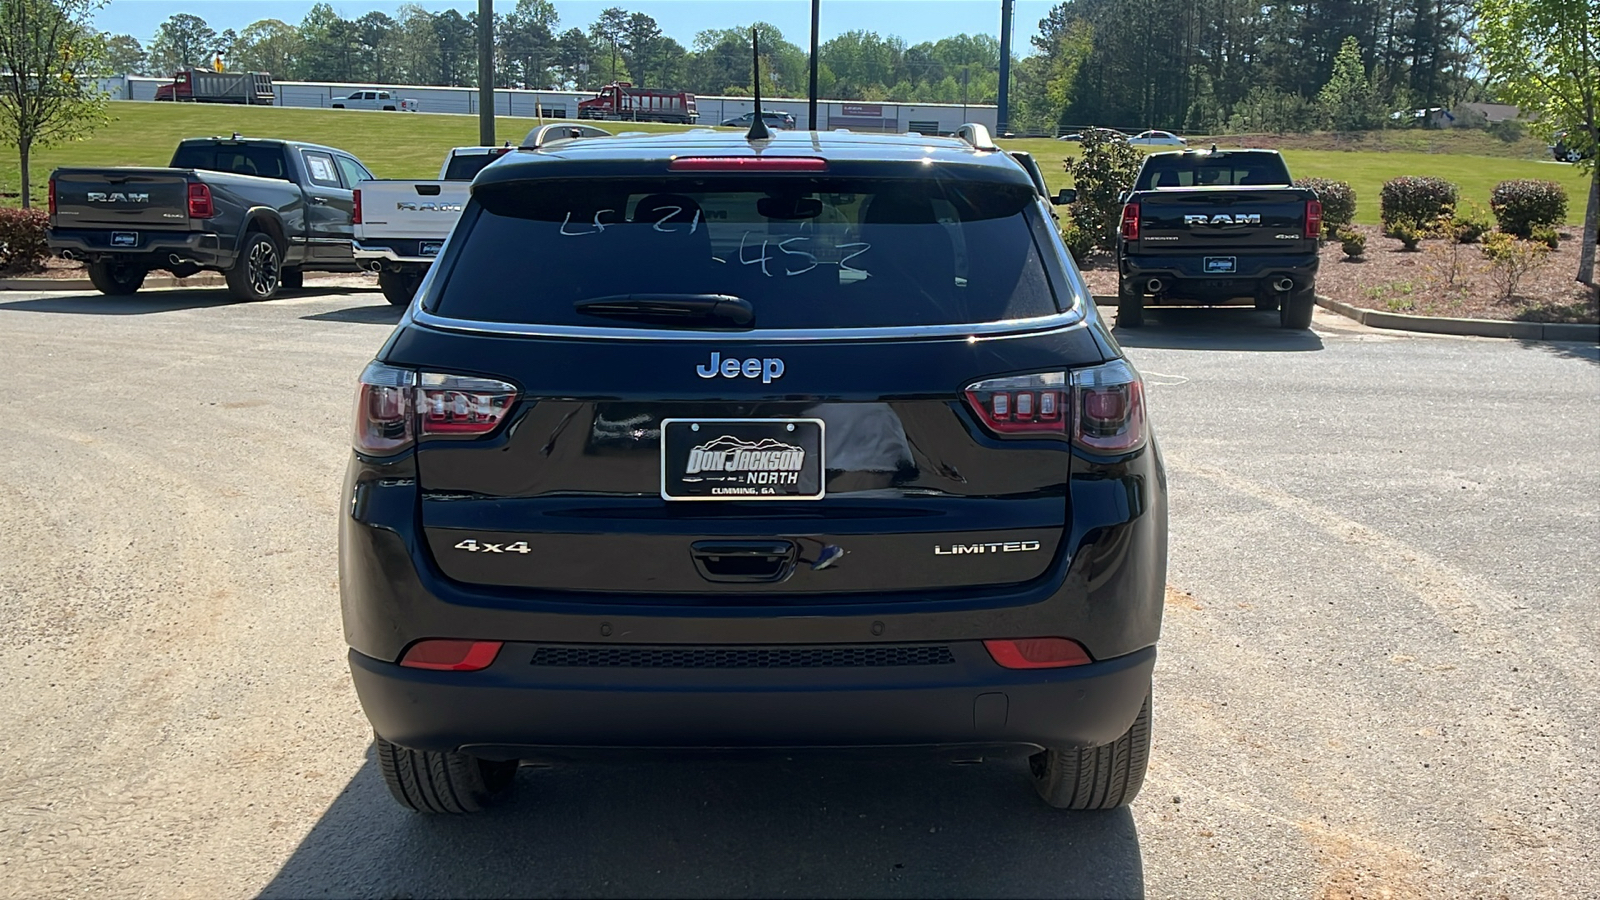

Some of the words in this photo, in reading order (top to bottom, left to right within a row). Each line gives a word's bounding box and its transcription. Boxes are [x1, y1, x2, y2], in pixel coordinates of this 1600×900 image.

[87, 192, 149, 203] RAM
[397, 201, 461, 212] RAM
[1184, 213, 1261, 225] RAM
[696, 351, 785, 384] Jeep
[746, 471, 799, 485] NORTH
[761, 487, 776, 495] GA
[454, 539, 532, 555] 4x4
[934, 540, 1041, 556] LIMITED
